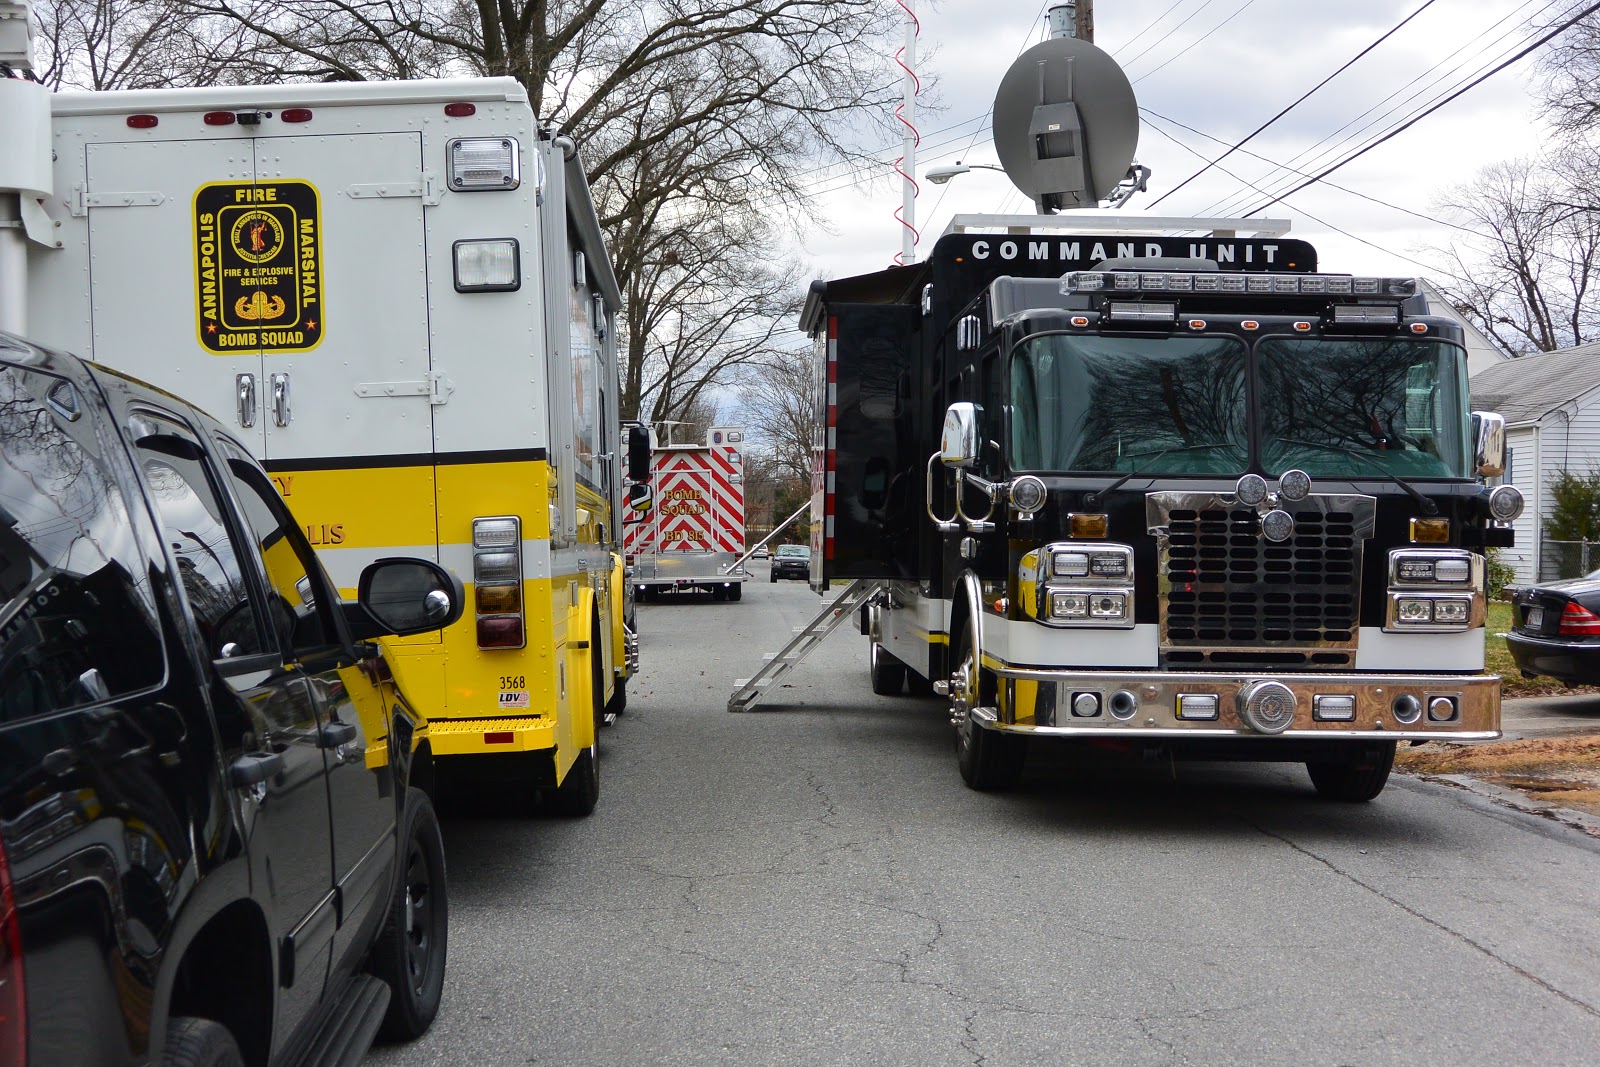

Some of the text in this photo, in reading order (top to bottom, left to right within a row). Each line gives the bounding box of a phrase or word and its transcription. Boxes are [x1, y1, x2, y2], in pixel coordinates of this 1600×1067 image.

[235, 188, 277, 202] FIRE
[971, 241, 1280, 263] COMMAND UNIT
[200, 212, 217, 321] ANNAPOLIS
[300, 218, 316, 308] MARSHAL
[224, 266, 294, 277] FIRE & EXPLOSIVE
[240, 277, 278, 287] SERVICES
[218, 331, 304, 347] BOMB SQUAD
[664, 490, 702, 501] BOMB
[661, 503, 706, 517] SQUAD
[664, 530, 704, 541] BD 815
[499, 675, 526, 690] 3568
[499, 693, 520, 702] LDV
